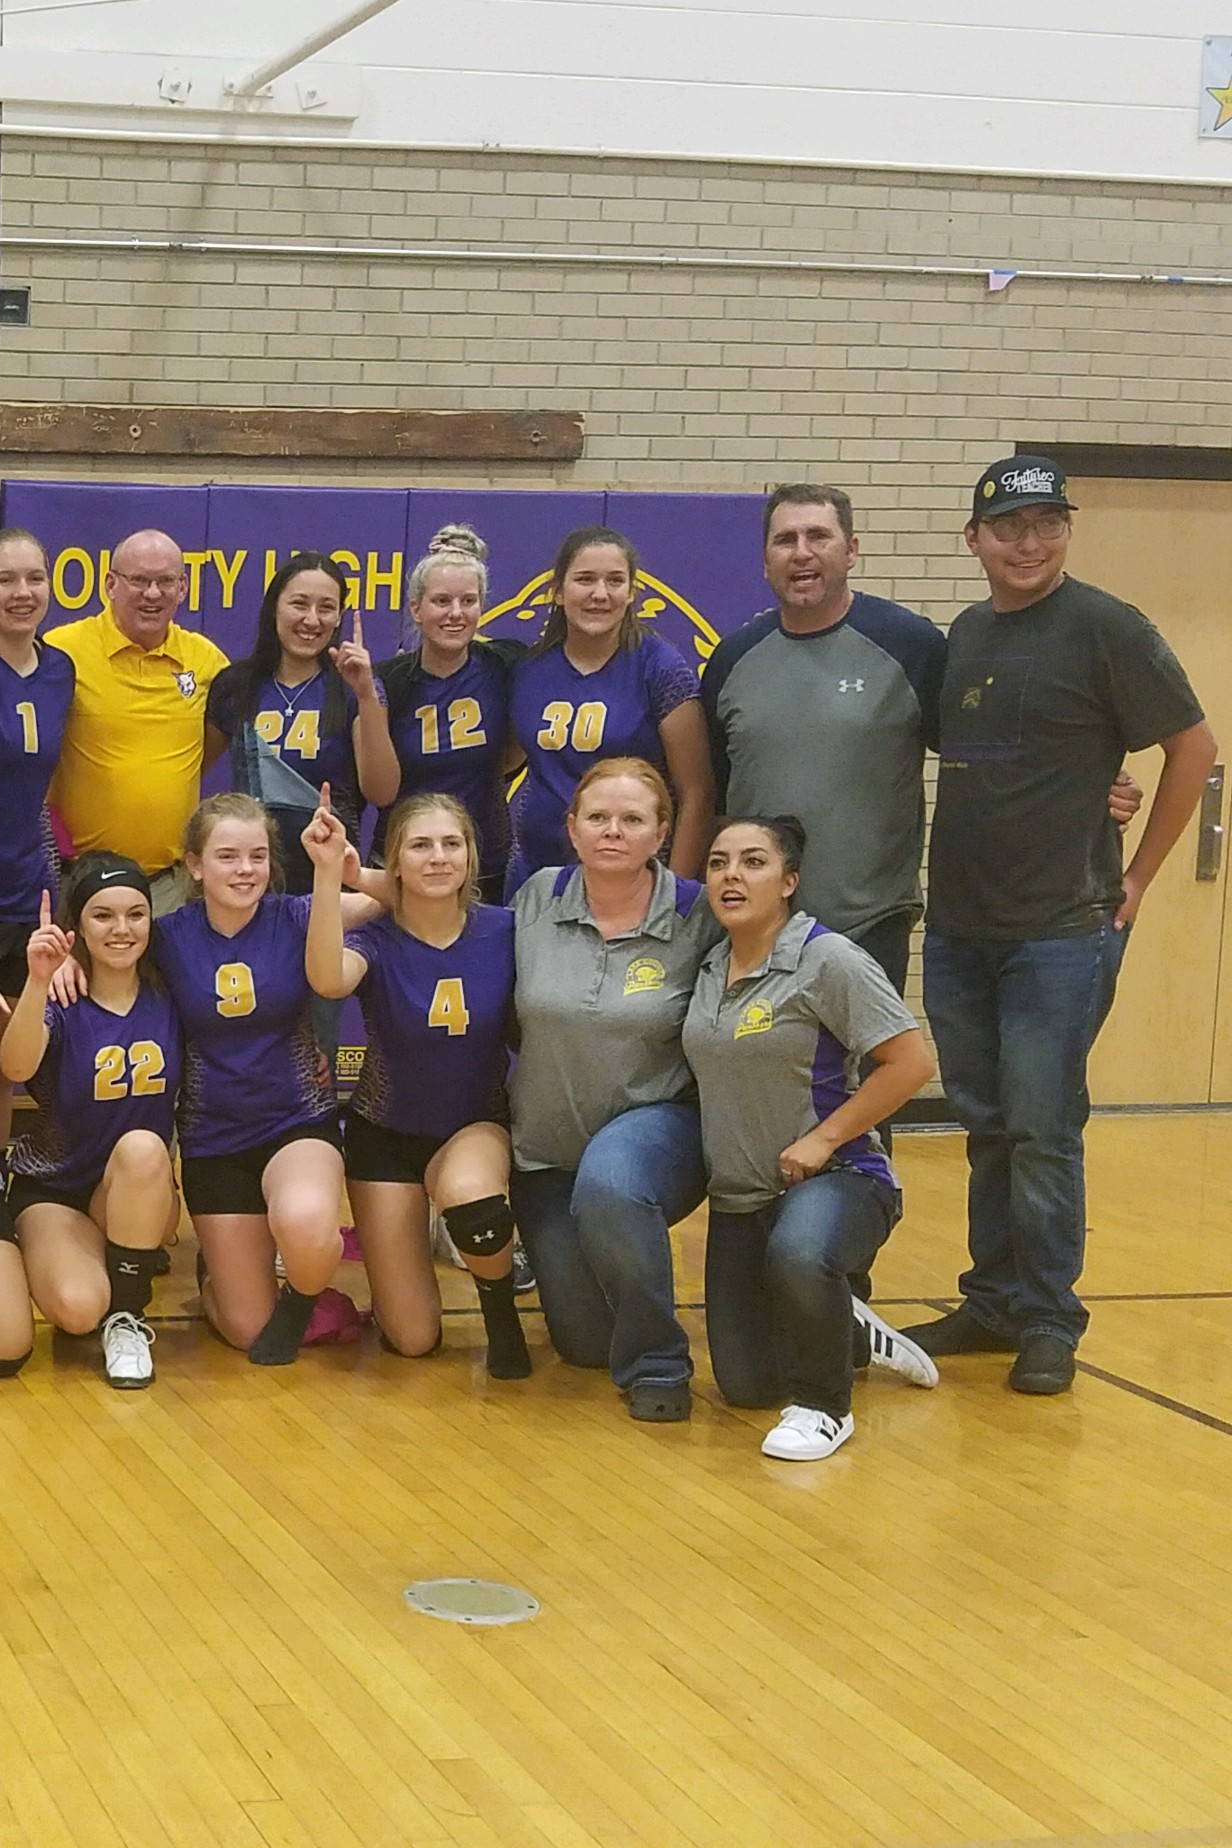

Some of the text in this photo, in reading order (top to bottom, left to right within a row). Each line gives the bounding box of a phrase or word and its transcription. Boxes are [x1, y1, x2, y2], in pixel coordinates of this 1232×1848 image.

[15, 701, 39, 754] 1
[253, 709, 320, 760] 24
[414, 697, 487, 755] 12
[536, 700, 607, 753] 30
[214, 962, 257, 1018] 9
[428, 977, 470, 1035] 4
[94, 1040, 167, 1101] 22
